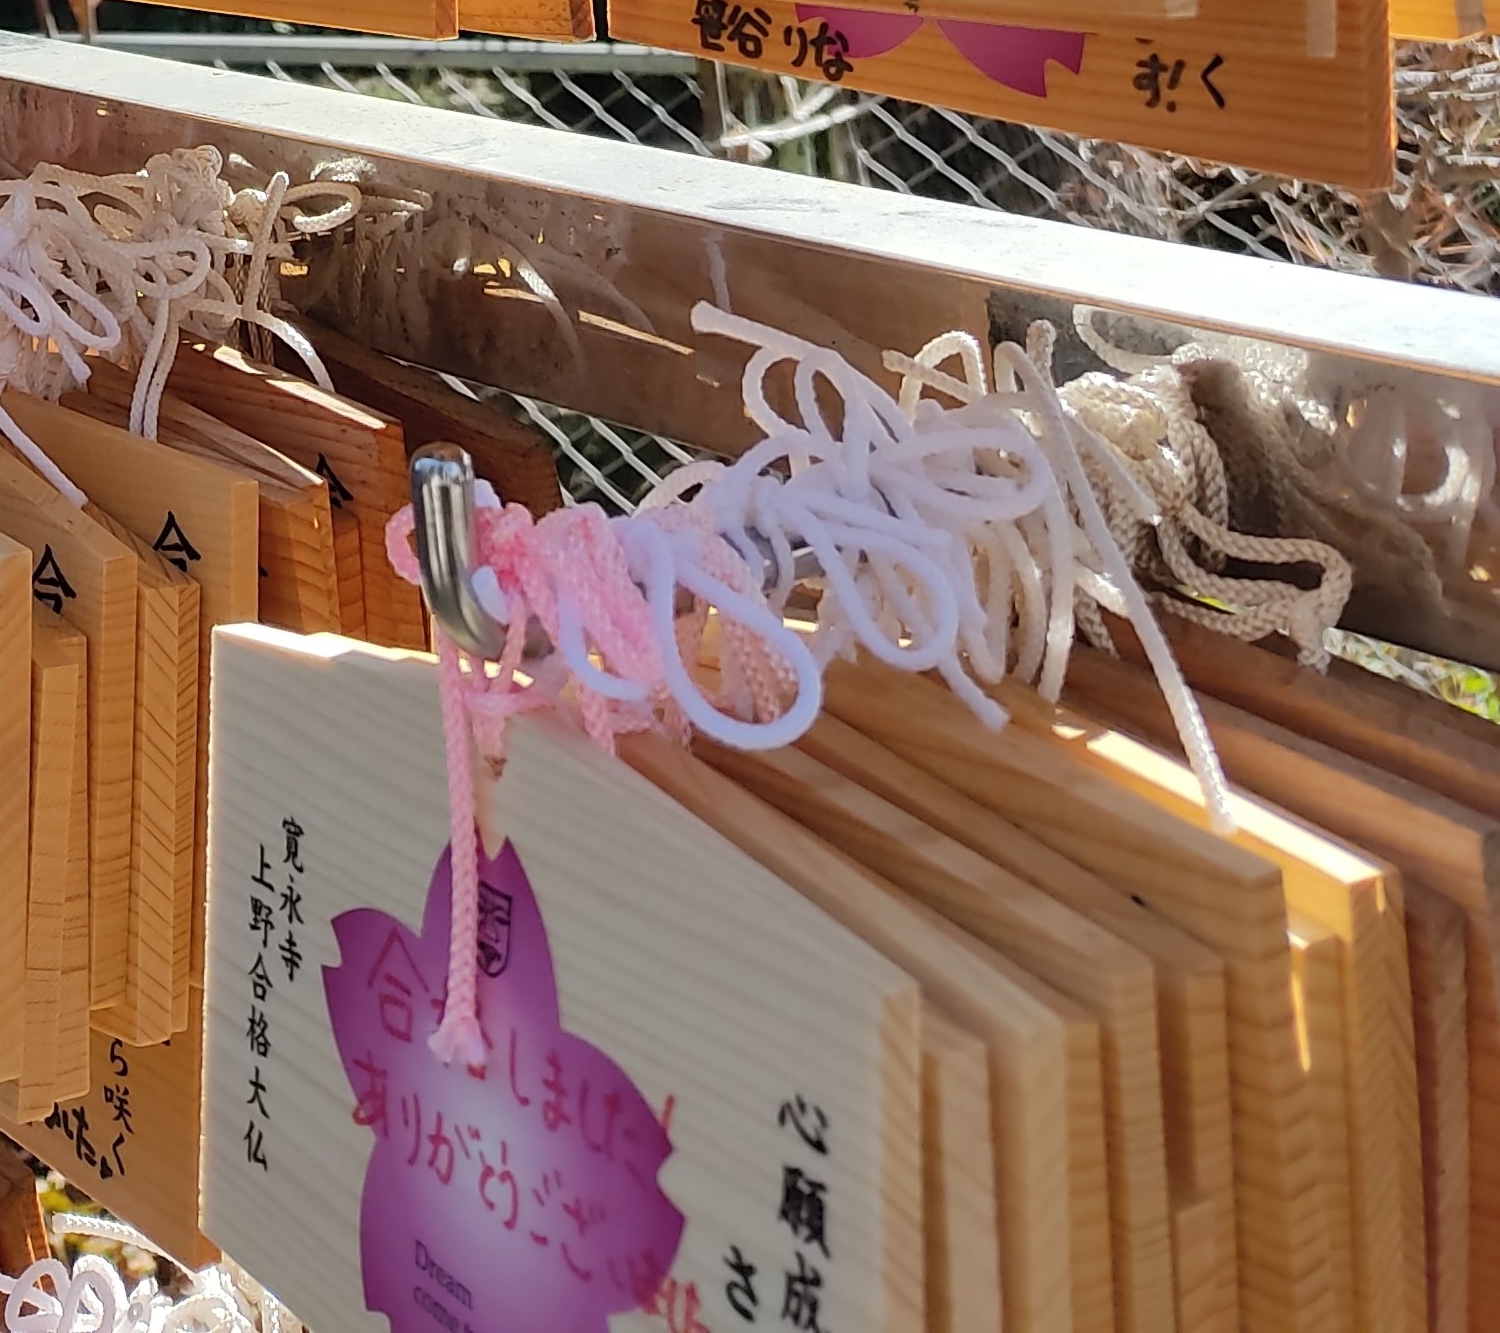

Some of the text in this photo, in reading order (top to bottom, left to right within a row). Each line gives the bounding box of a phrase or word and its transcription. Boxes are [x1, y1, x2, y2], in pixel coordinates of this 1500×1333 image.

[279, 816, 306, 982] 寛永寺
[244, 845, 276, 1173] 上野合格大仏
[415, 1239, 474, 1310] Dream
